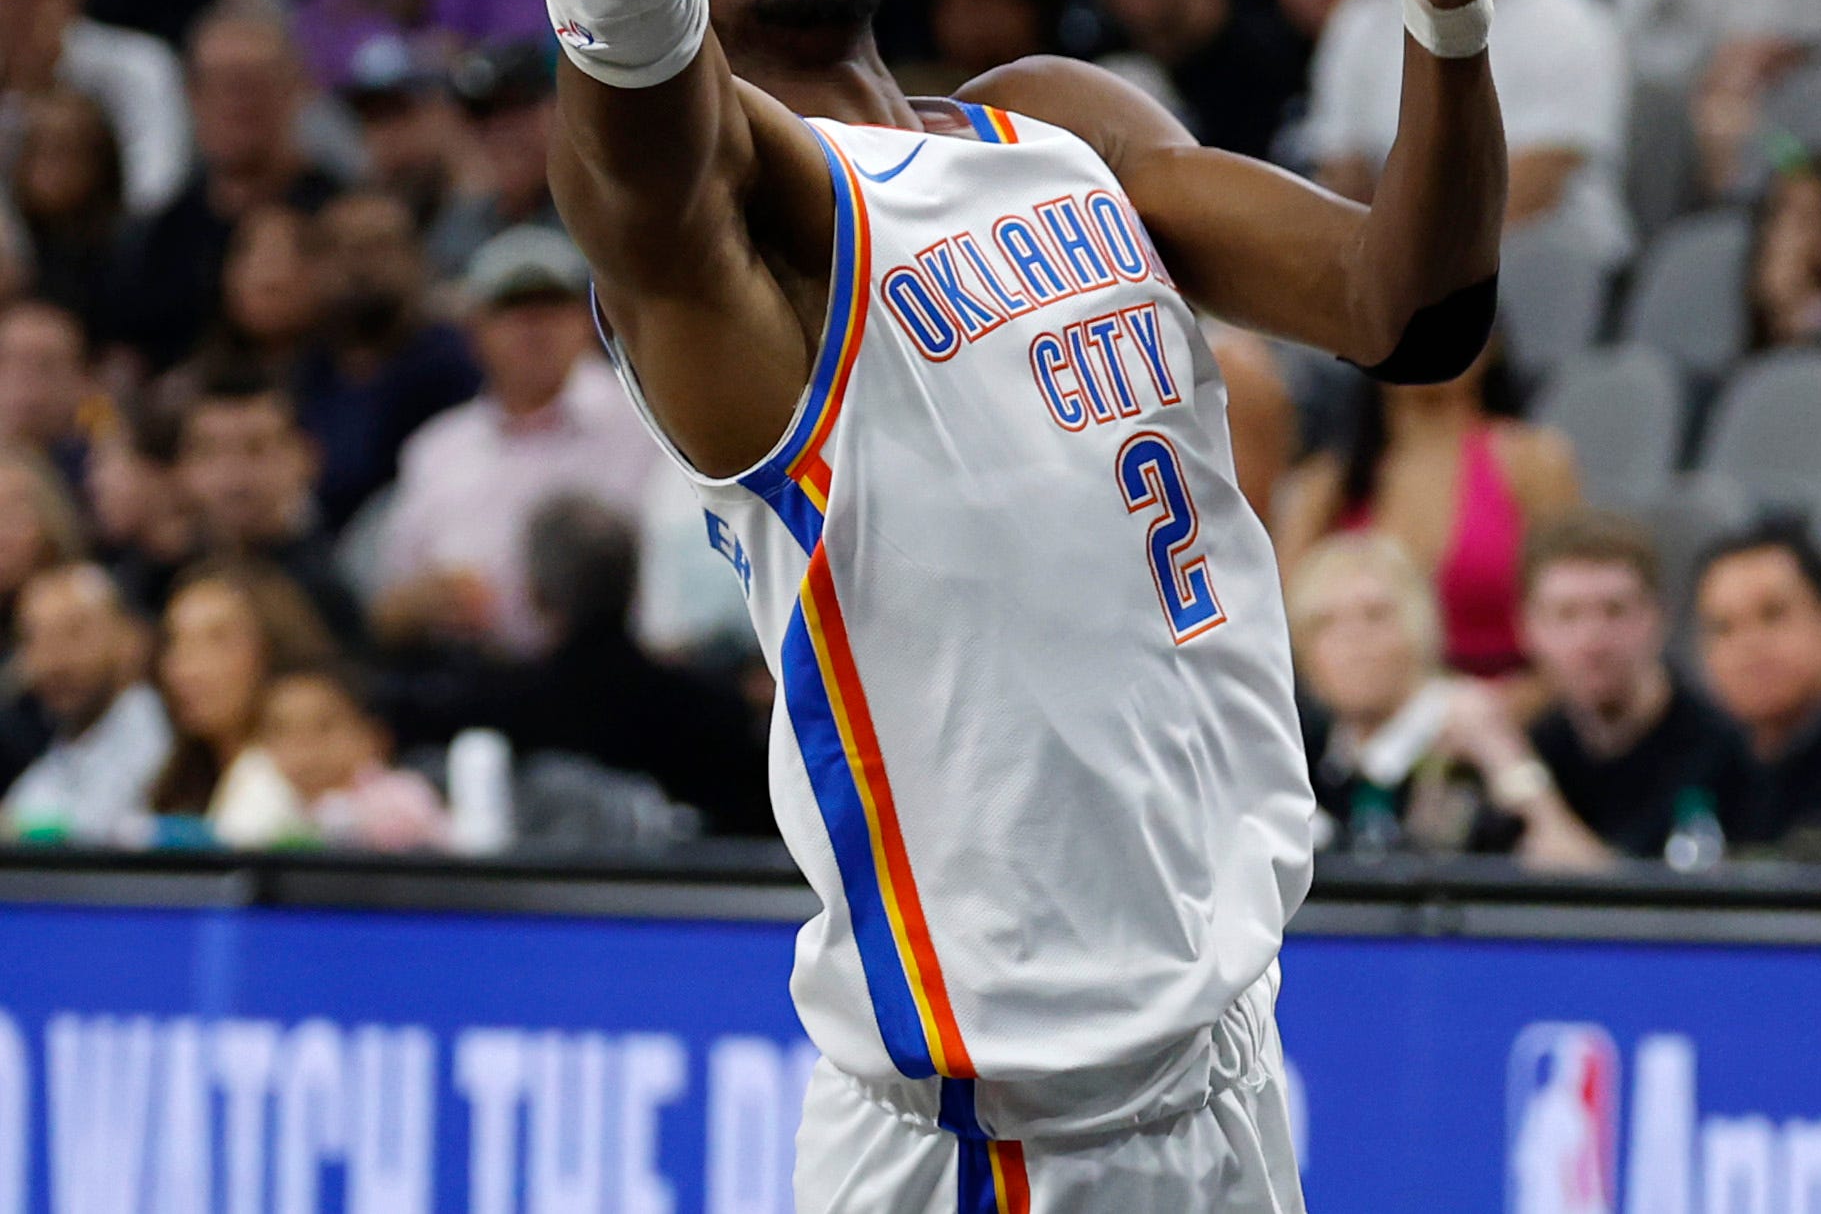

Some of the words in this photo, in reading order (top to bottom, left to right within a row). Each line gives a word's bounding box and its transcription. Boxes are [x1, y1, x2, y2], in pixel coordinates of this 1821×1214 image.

[881, 189, 1176, 363] OKLAHO
[1029, 301, 1182, 433] CITY
[1115, 430, 1228, 646] 2
